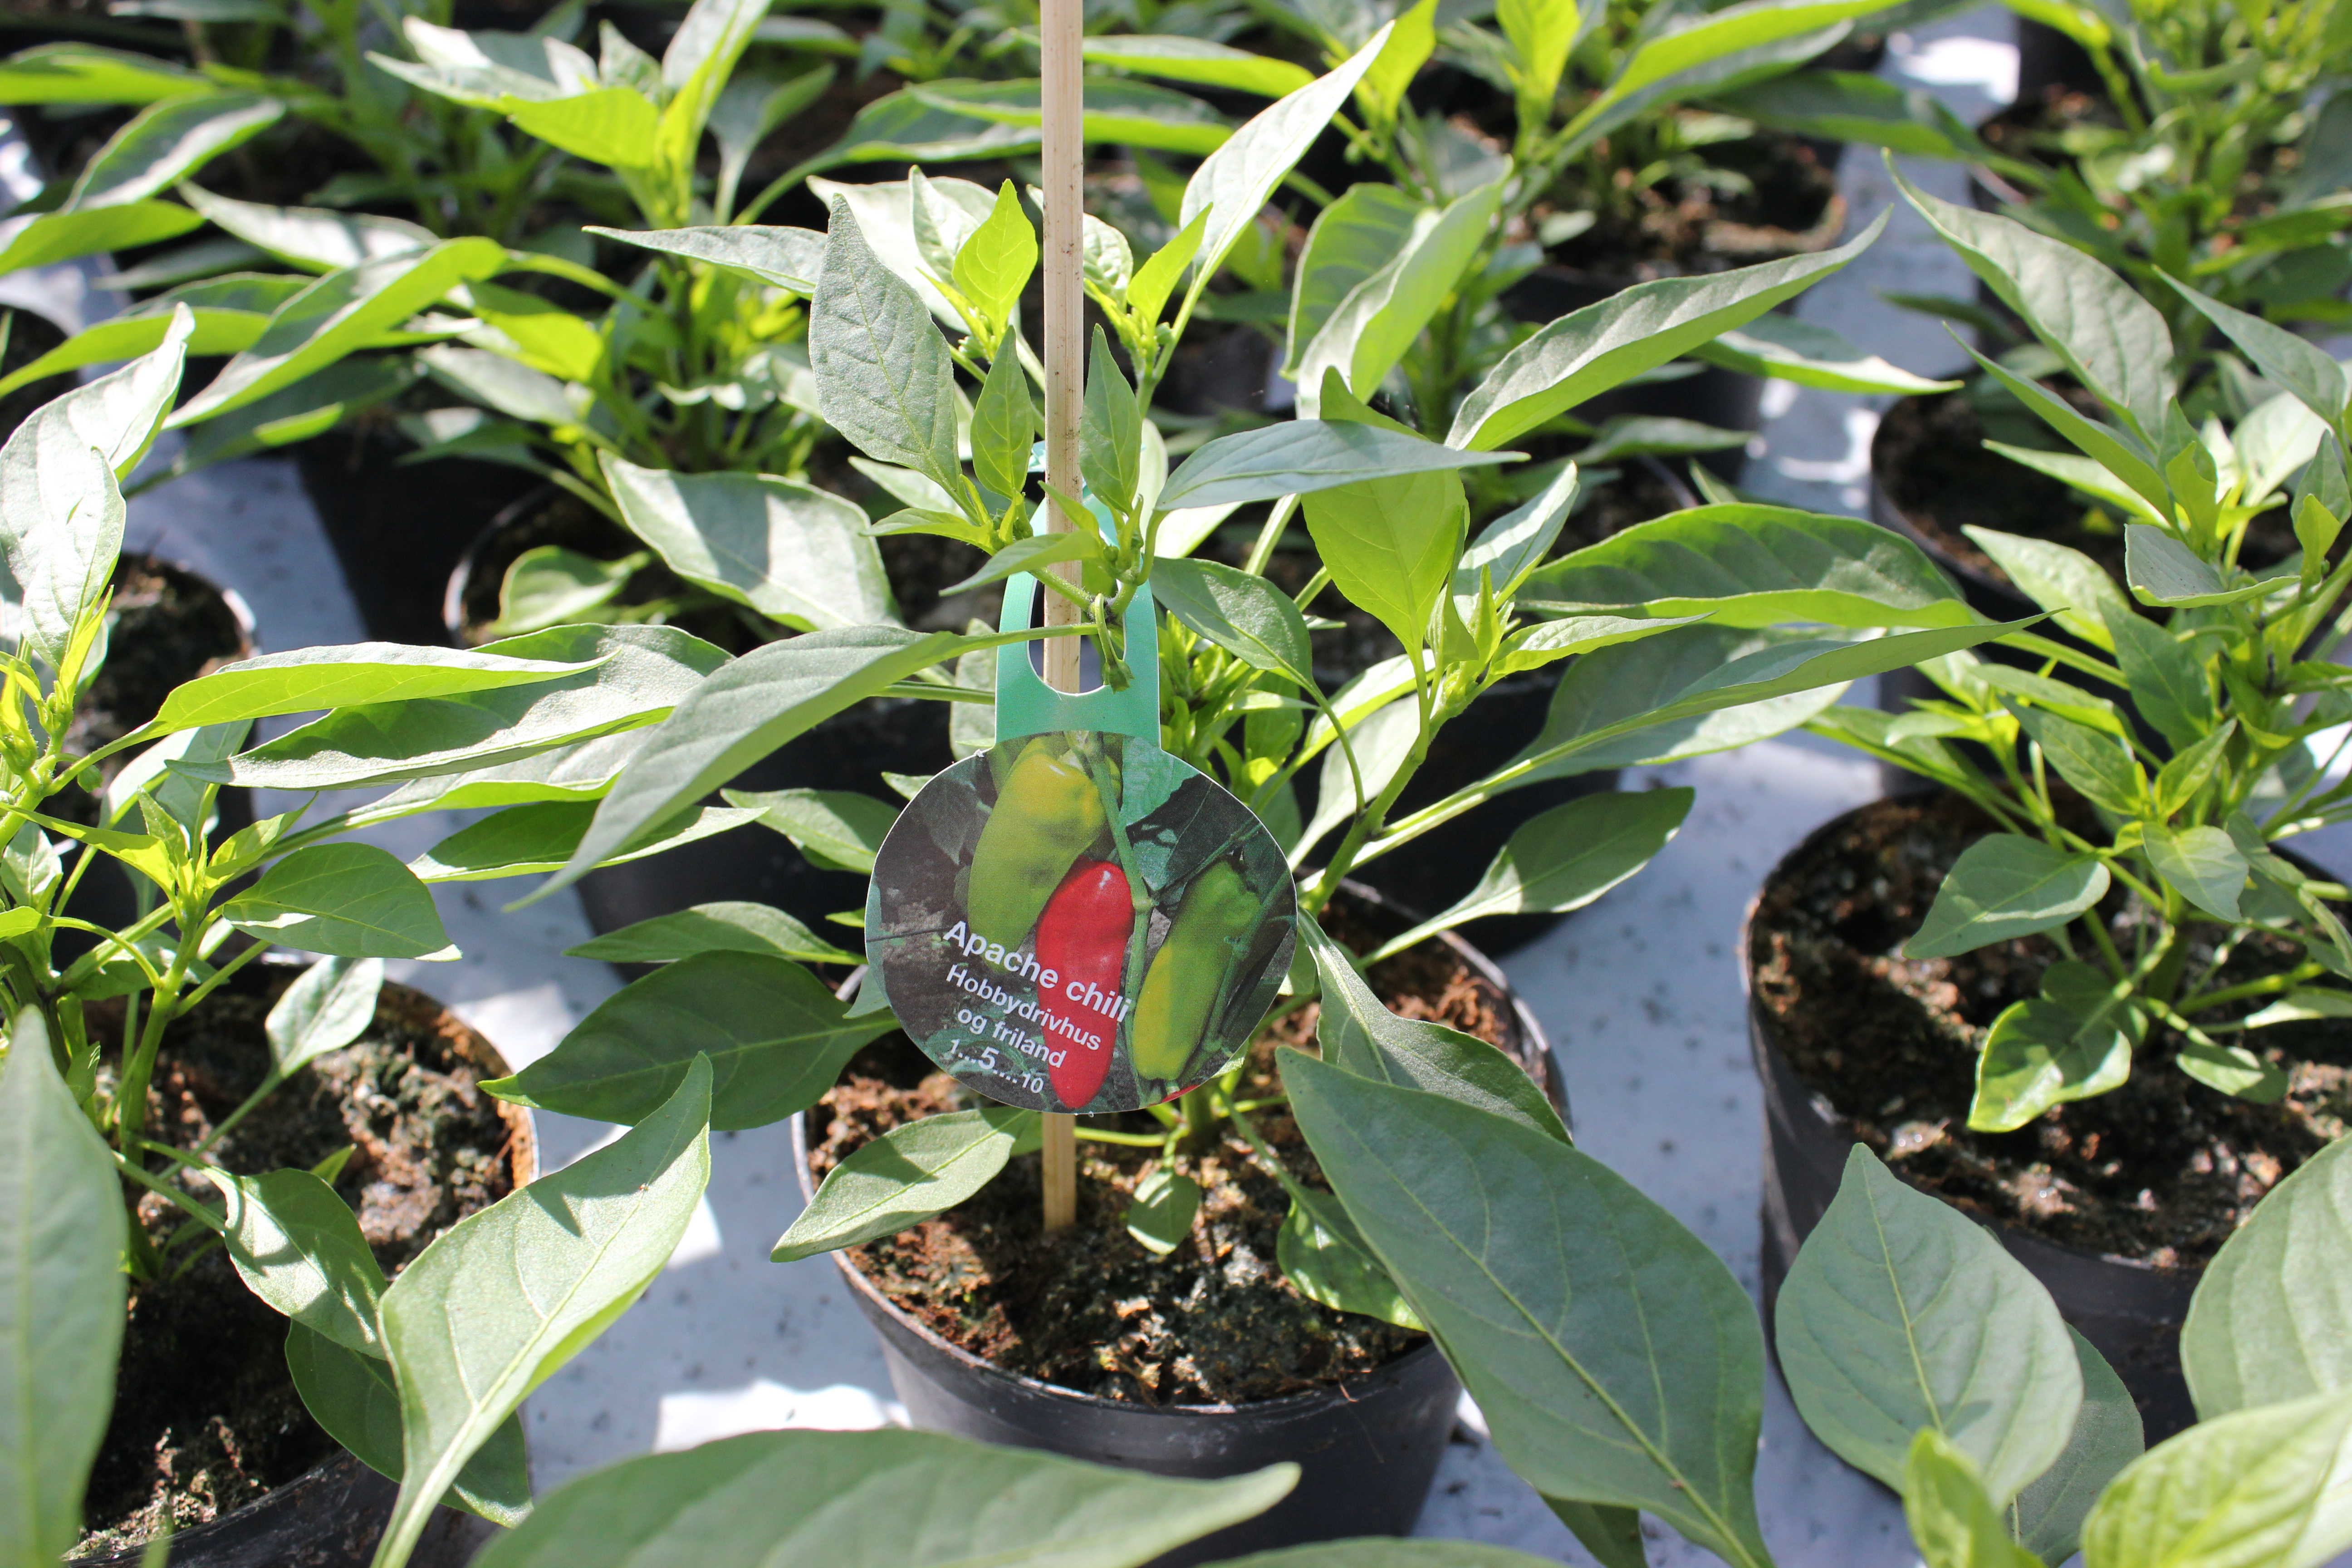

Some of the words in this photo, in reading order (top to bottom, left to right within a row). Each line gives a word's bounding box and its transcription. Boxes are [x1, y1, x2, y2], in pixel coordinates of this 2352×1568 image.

[943, 921, 1058, 989] Apache
[1066, 981, 1132, 1023] chili
[946, 965, 1102, 1051] Hobbydrivhus
[958, 1009, 988, 1034] og
[992, 1020, 1067, 1068] friland
